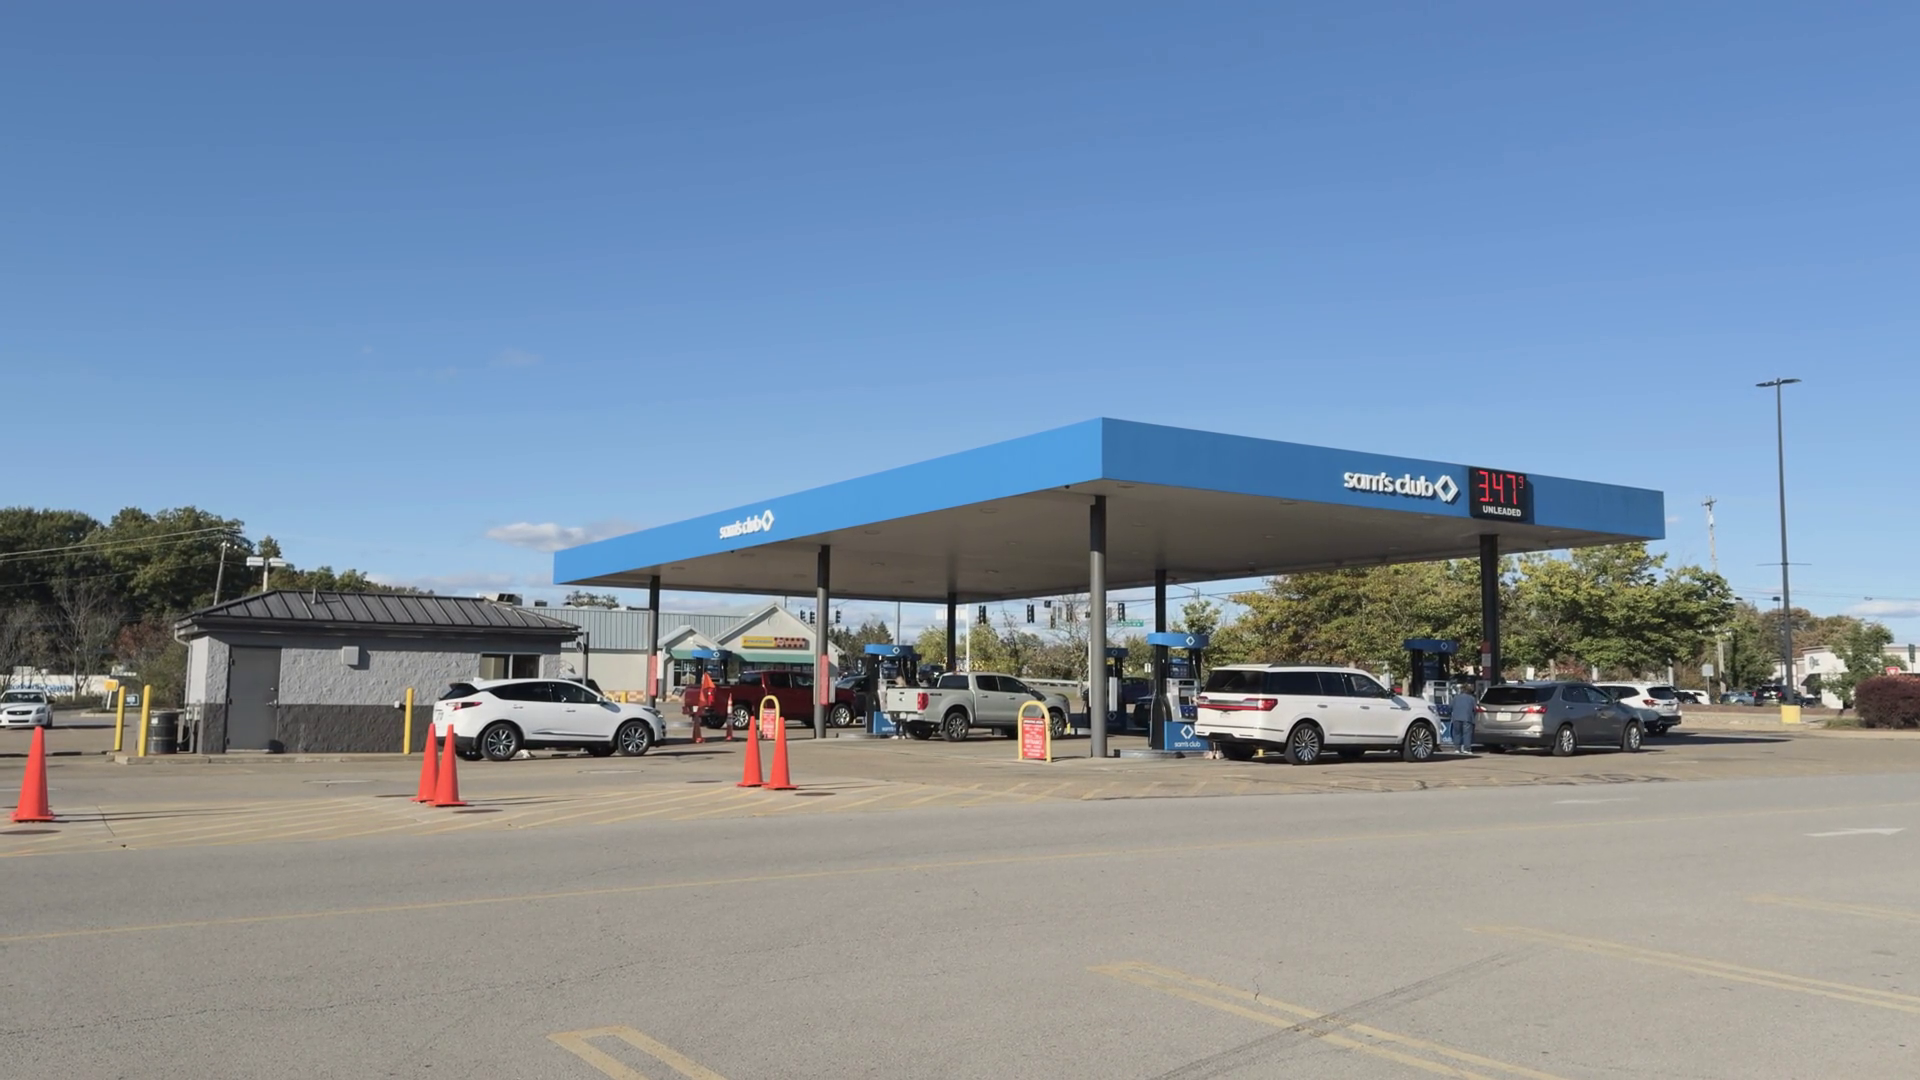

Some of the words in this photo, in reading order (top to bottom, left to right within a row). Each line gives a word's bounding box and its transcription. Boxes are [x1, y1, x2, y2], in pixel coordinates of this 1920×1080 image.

[1343, 472, 1395, 493] sam's
[1395, 474, 1434, 497] club
[1482, 505, 1522, 517] UNLEADED
[742, 514, 762, 535] club
[1189, 740, 1201, 748] club
